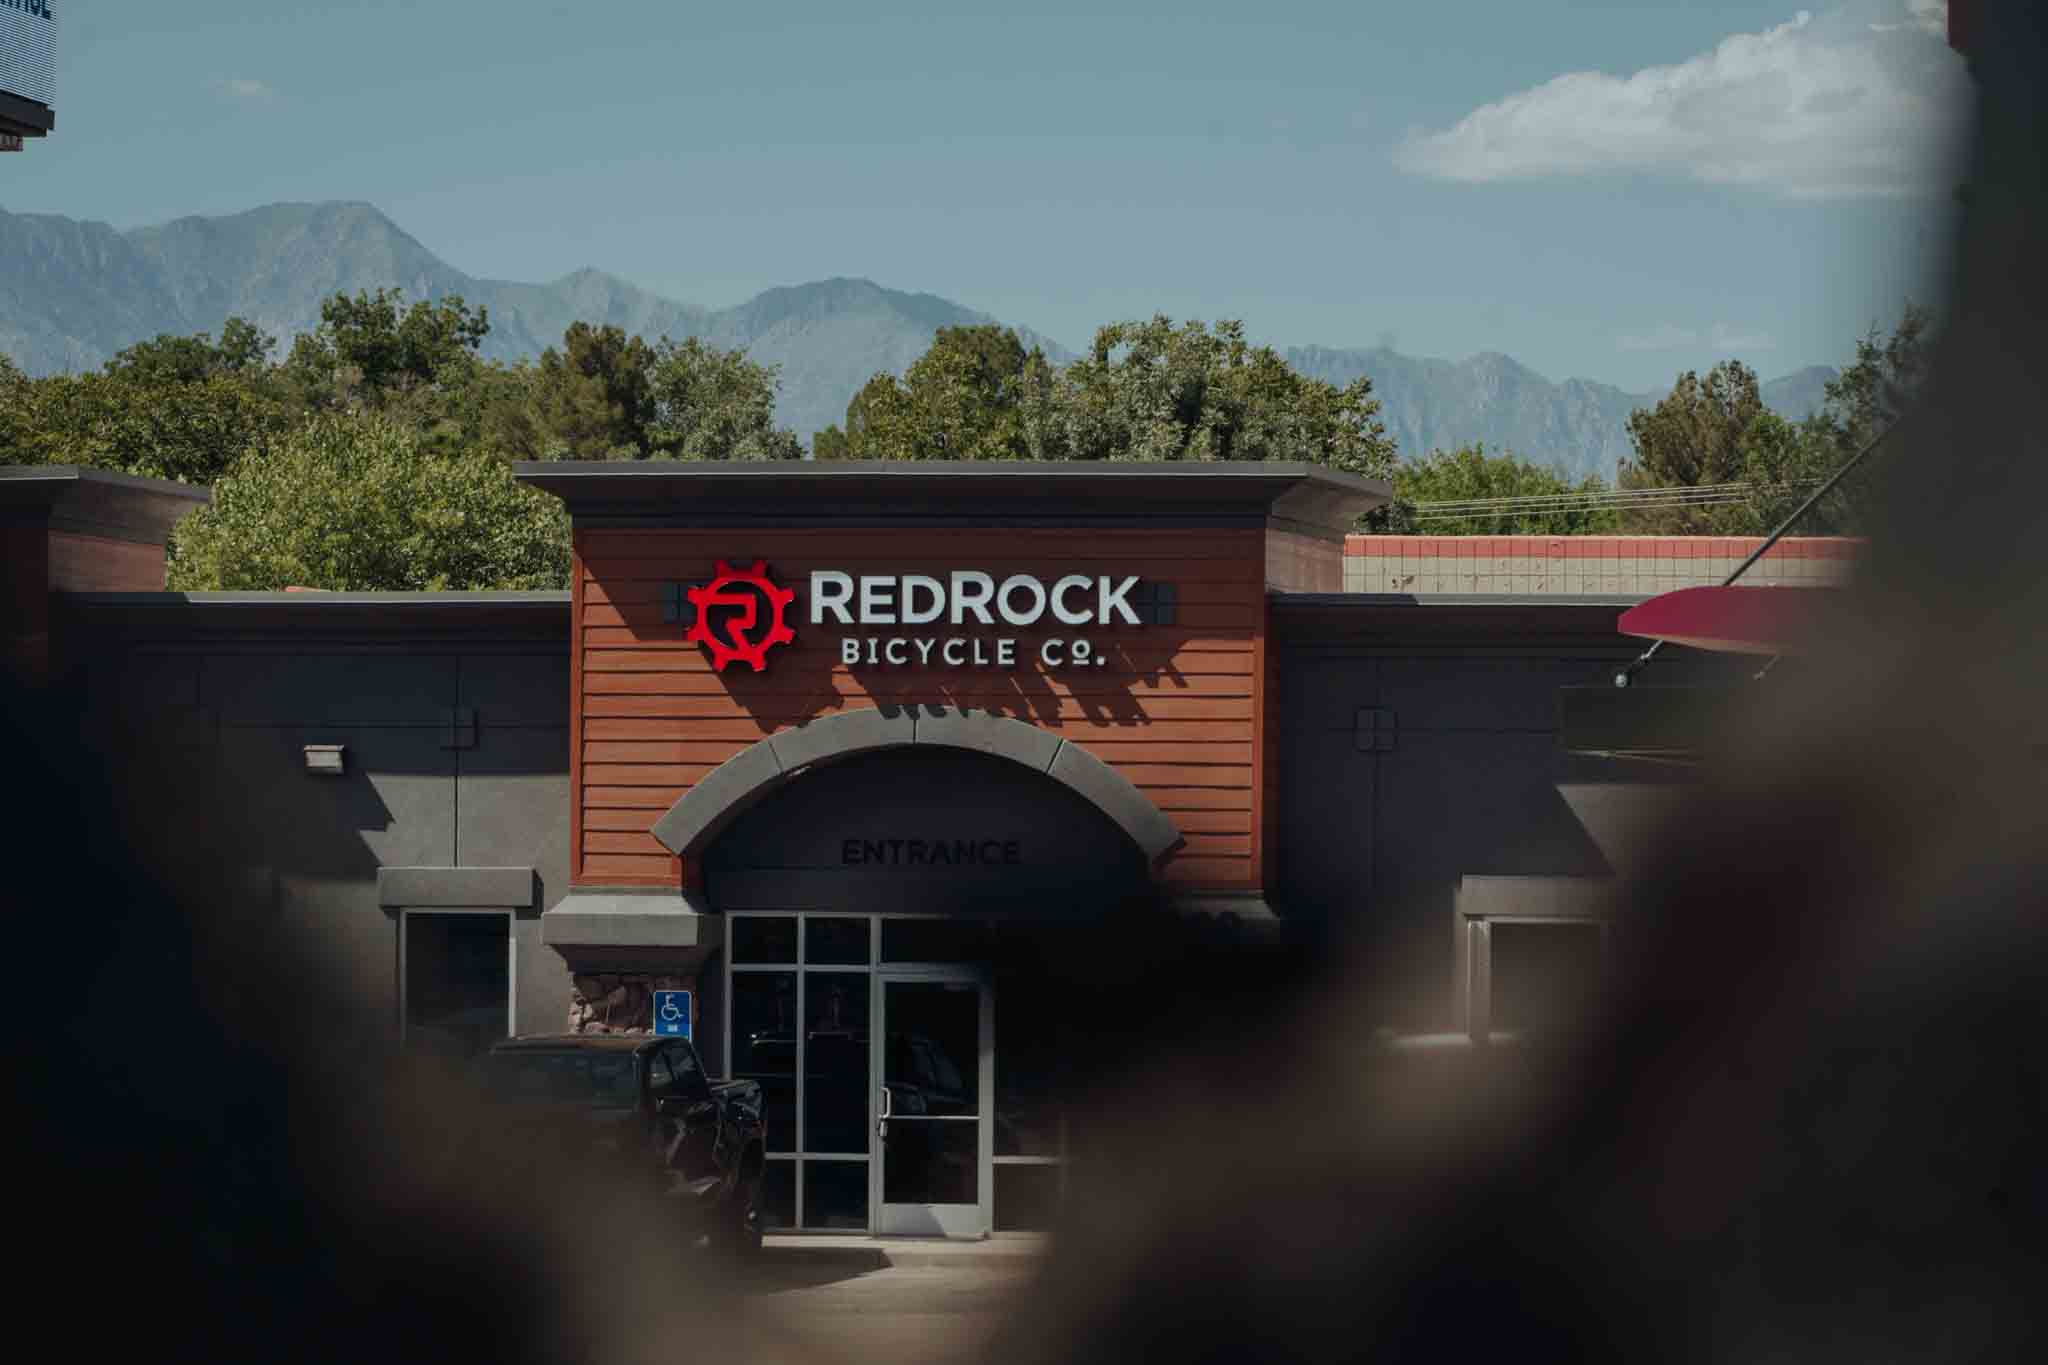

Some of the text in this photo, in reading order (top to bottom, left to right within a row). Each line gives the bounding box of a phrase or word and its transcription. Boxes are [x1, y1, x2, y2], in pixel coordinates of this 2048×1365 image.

[811, 571, 1141, 625] REDROCK
[841, 639, 1016, 666] BICYCLE
[841, 839, 1021, 864] ENTRANCE
